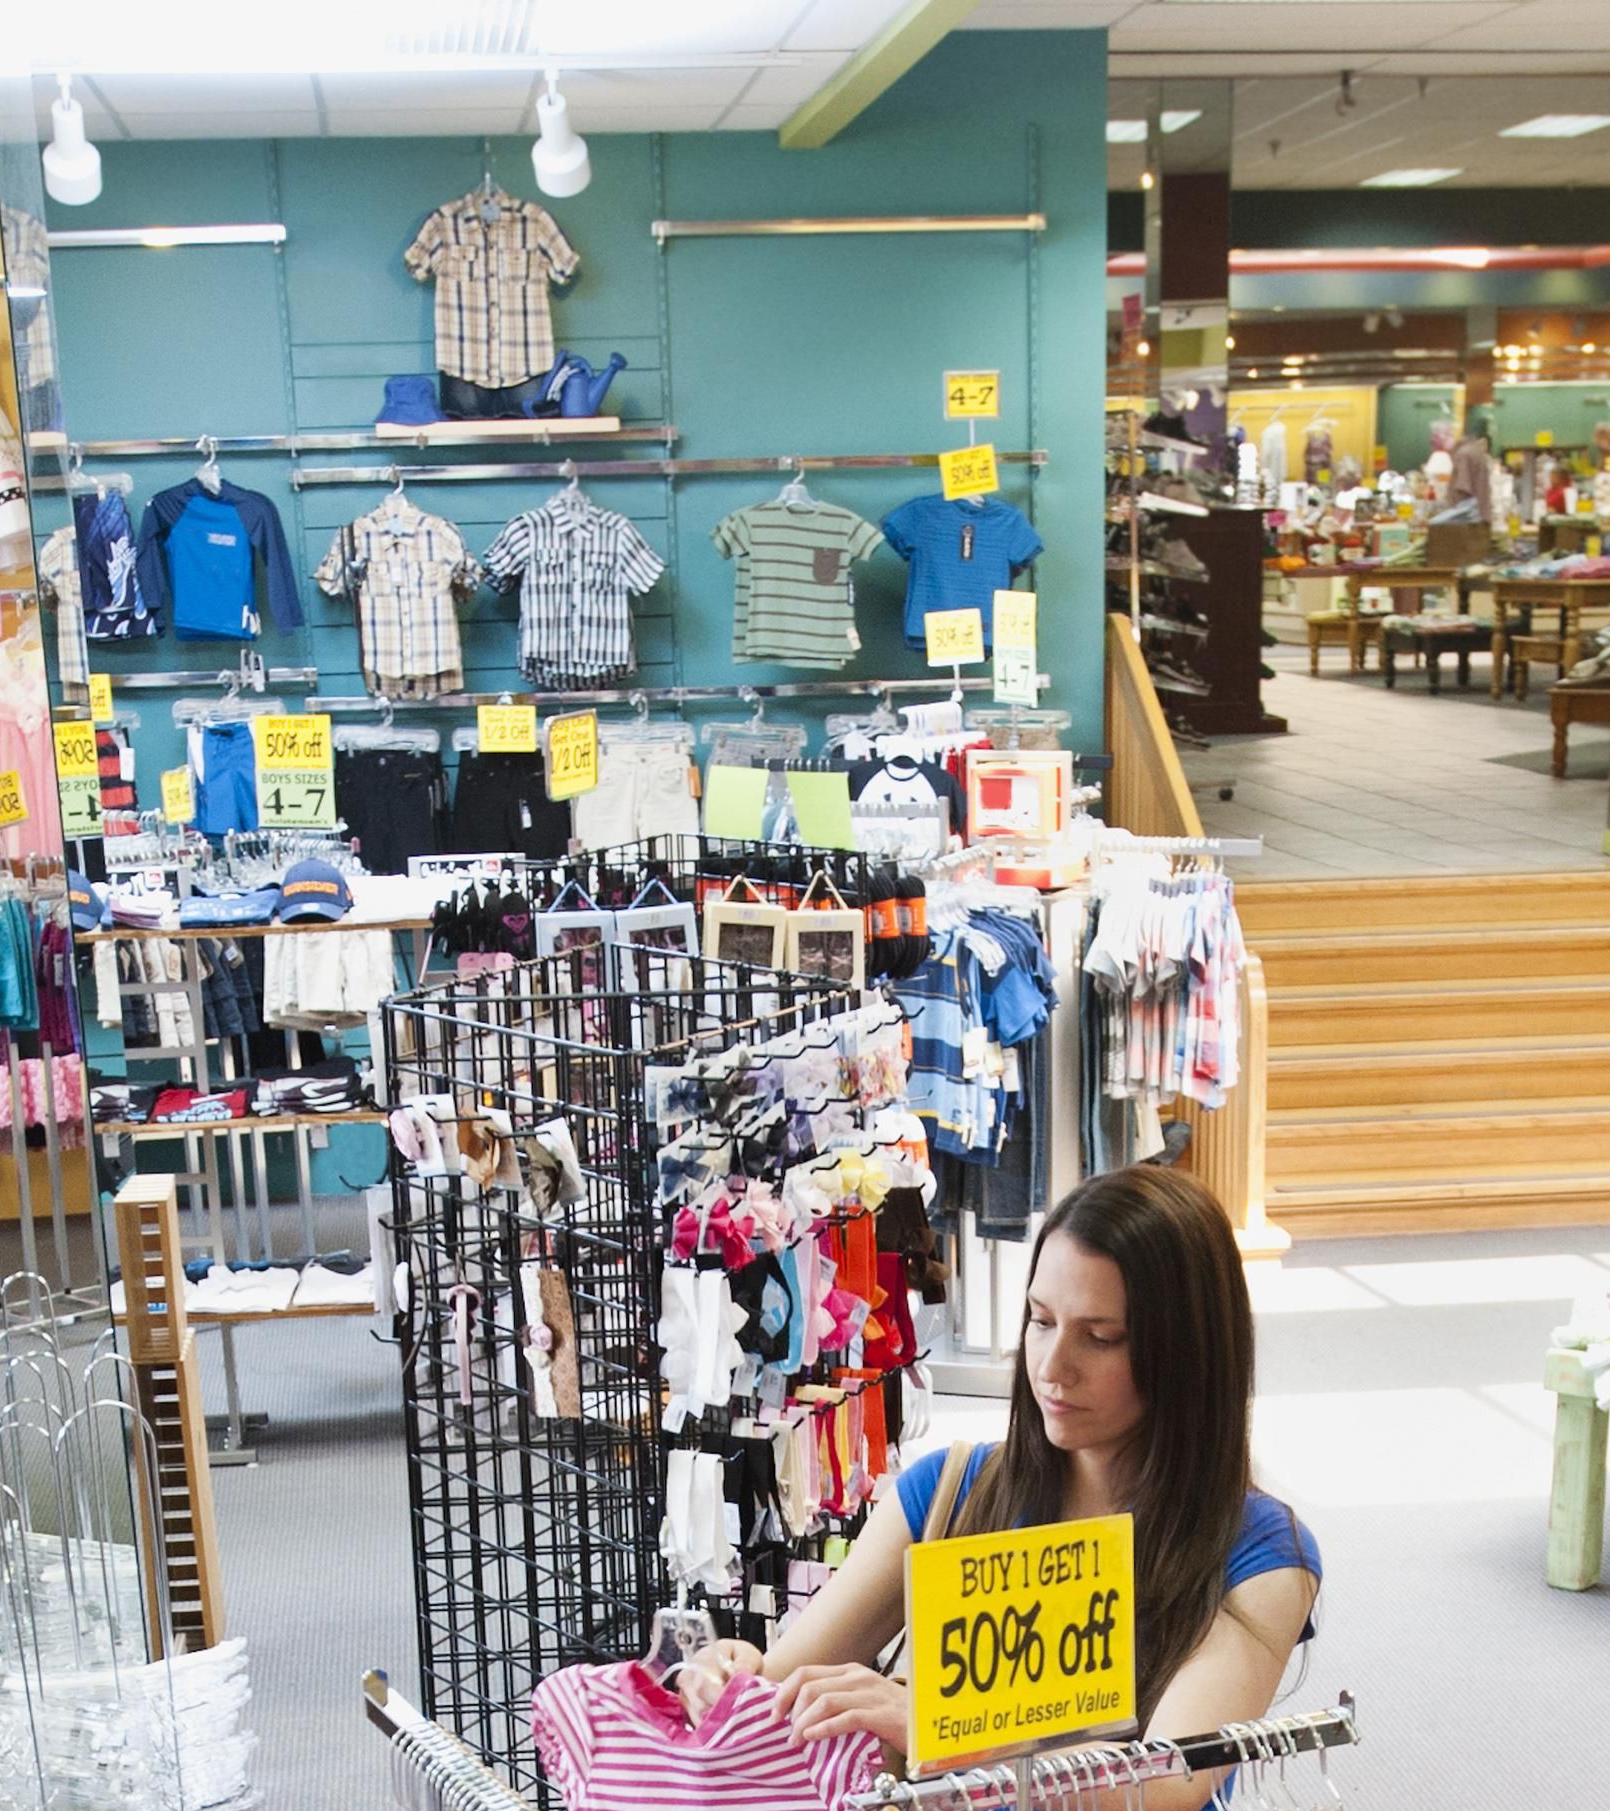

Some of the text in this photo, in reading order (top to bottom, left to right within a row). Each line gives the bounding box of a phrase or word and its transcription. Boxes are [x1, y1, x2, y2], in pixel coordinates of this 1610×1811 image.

[950, 387, 994, 406] 4-7
[266, 732, 323, 758] 50% off
[262, 773, 327, 784] BOYS SIZES
[263, 788, 326, 816] 4-7
[960, 1539, 1100, 1598] BUY 1 GET 1
[940, 1588, 1119, 1698] 50% off
[993, 1710, 1010, 1731] or
[1015, 1700, 1071, 1727] Lesser
[1076, 1688, 1120, 1714] Value
